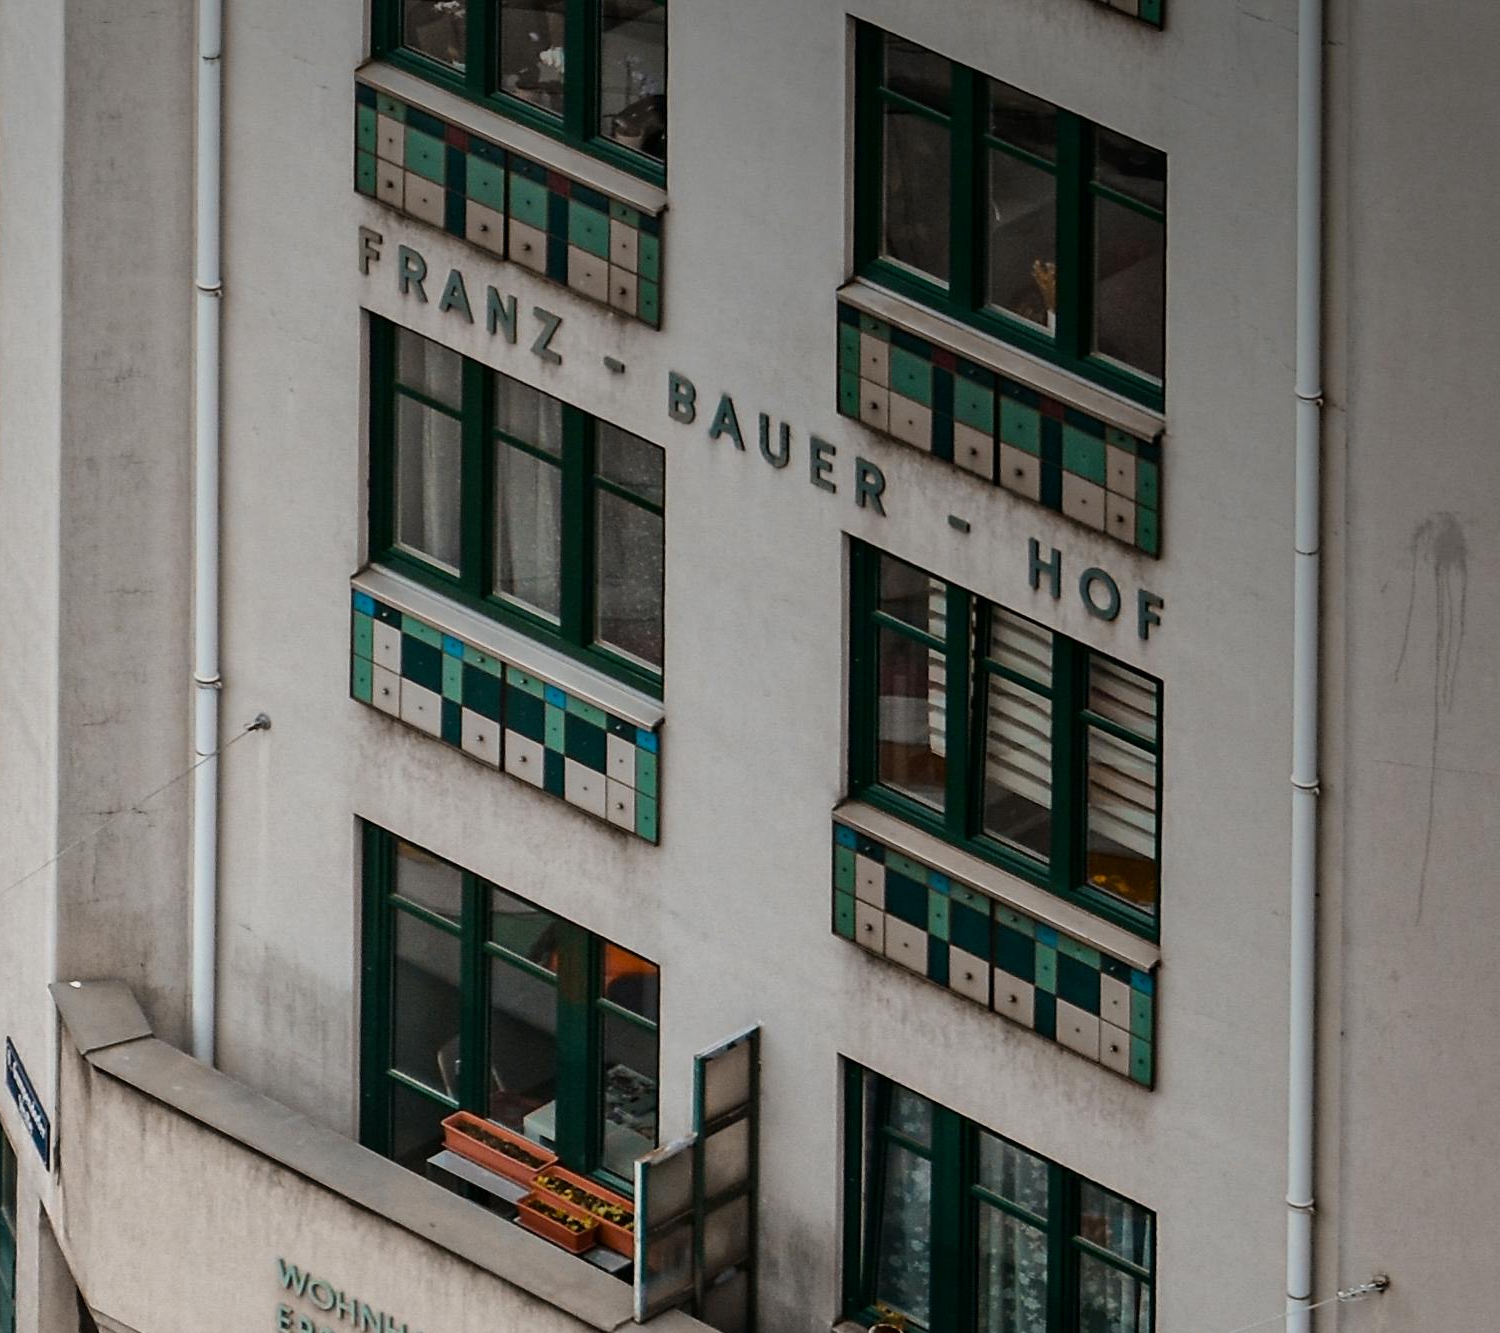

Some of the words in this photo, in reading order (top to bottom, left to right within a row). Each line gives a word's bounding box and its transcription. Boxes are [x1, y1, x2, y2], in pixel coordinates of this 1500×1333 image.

[358, 225, 563, 366] FRANZ
[667, 370, 887, 518] BAUER
[1027, 536, 1165, 641] HOF
